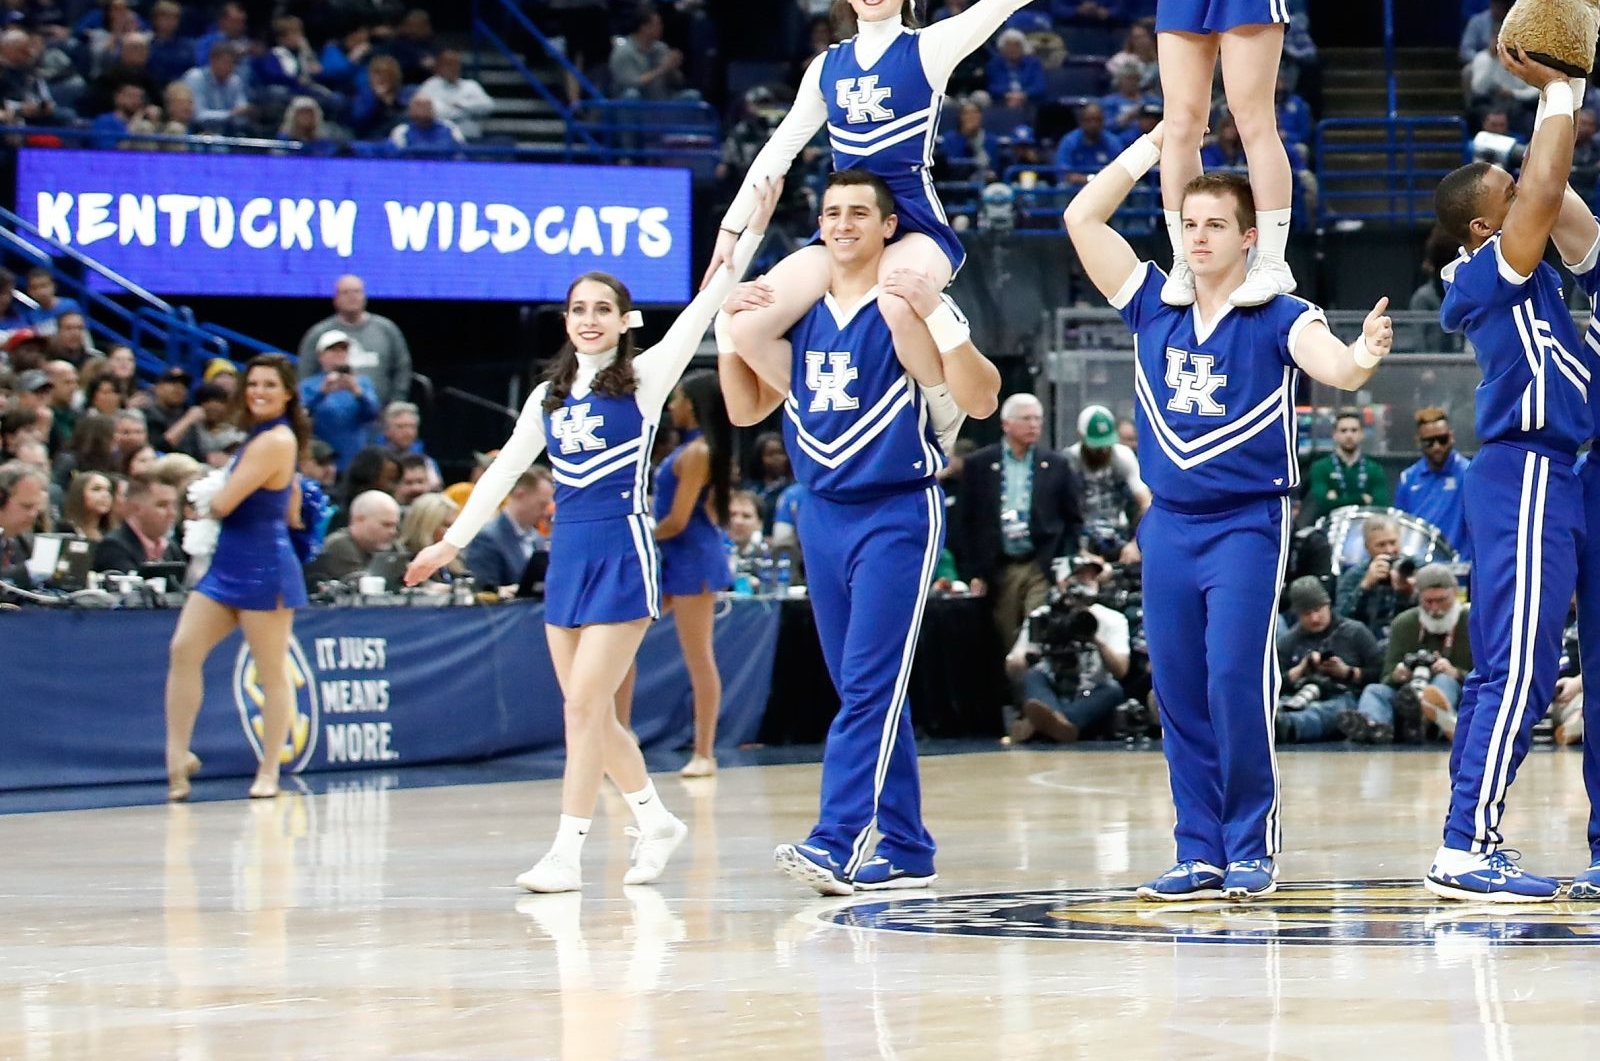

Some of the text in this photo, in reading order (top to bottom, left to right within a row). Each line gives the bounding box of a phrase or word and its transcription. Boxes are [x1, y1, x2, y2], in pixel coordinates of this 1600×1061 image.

[836, 75, 896, 125] UK
[36, 191, 672, 258] KENTUCKY WILDCATS
[805, 351, 860, 413] UK
[1165, 347, 1228, 416] UK
[551, 403, 607, 455] UK
[315, 637, 387, 670] IT JUST
[320, 679, 390, 713] MEANS
[326, 722, 399, 762] MORE.
